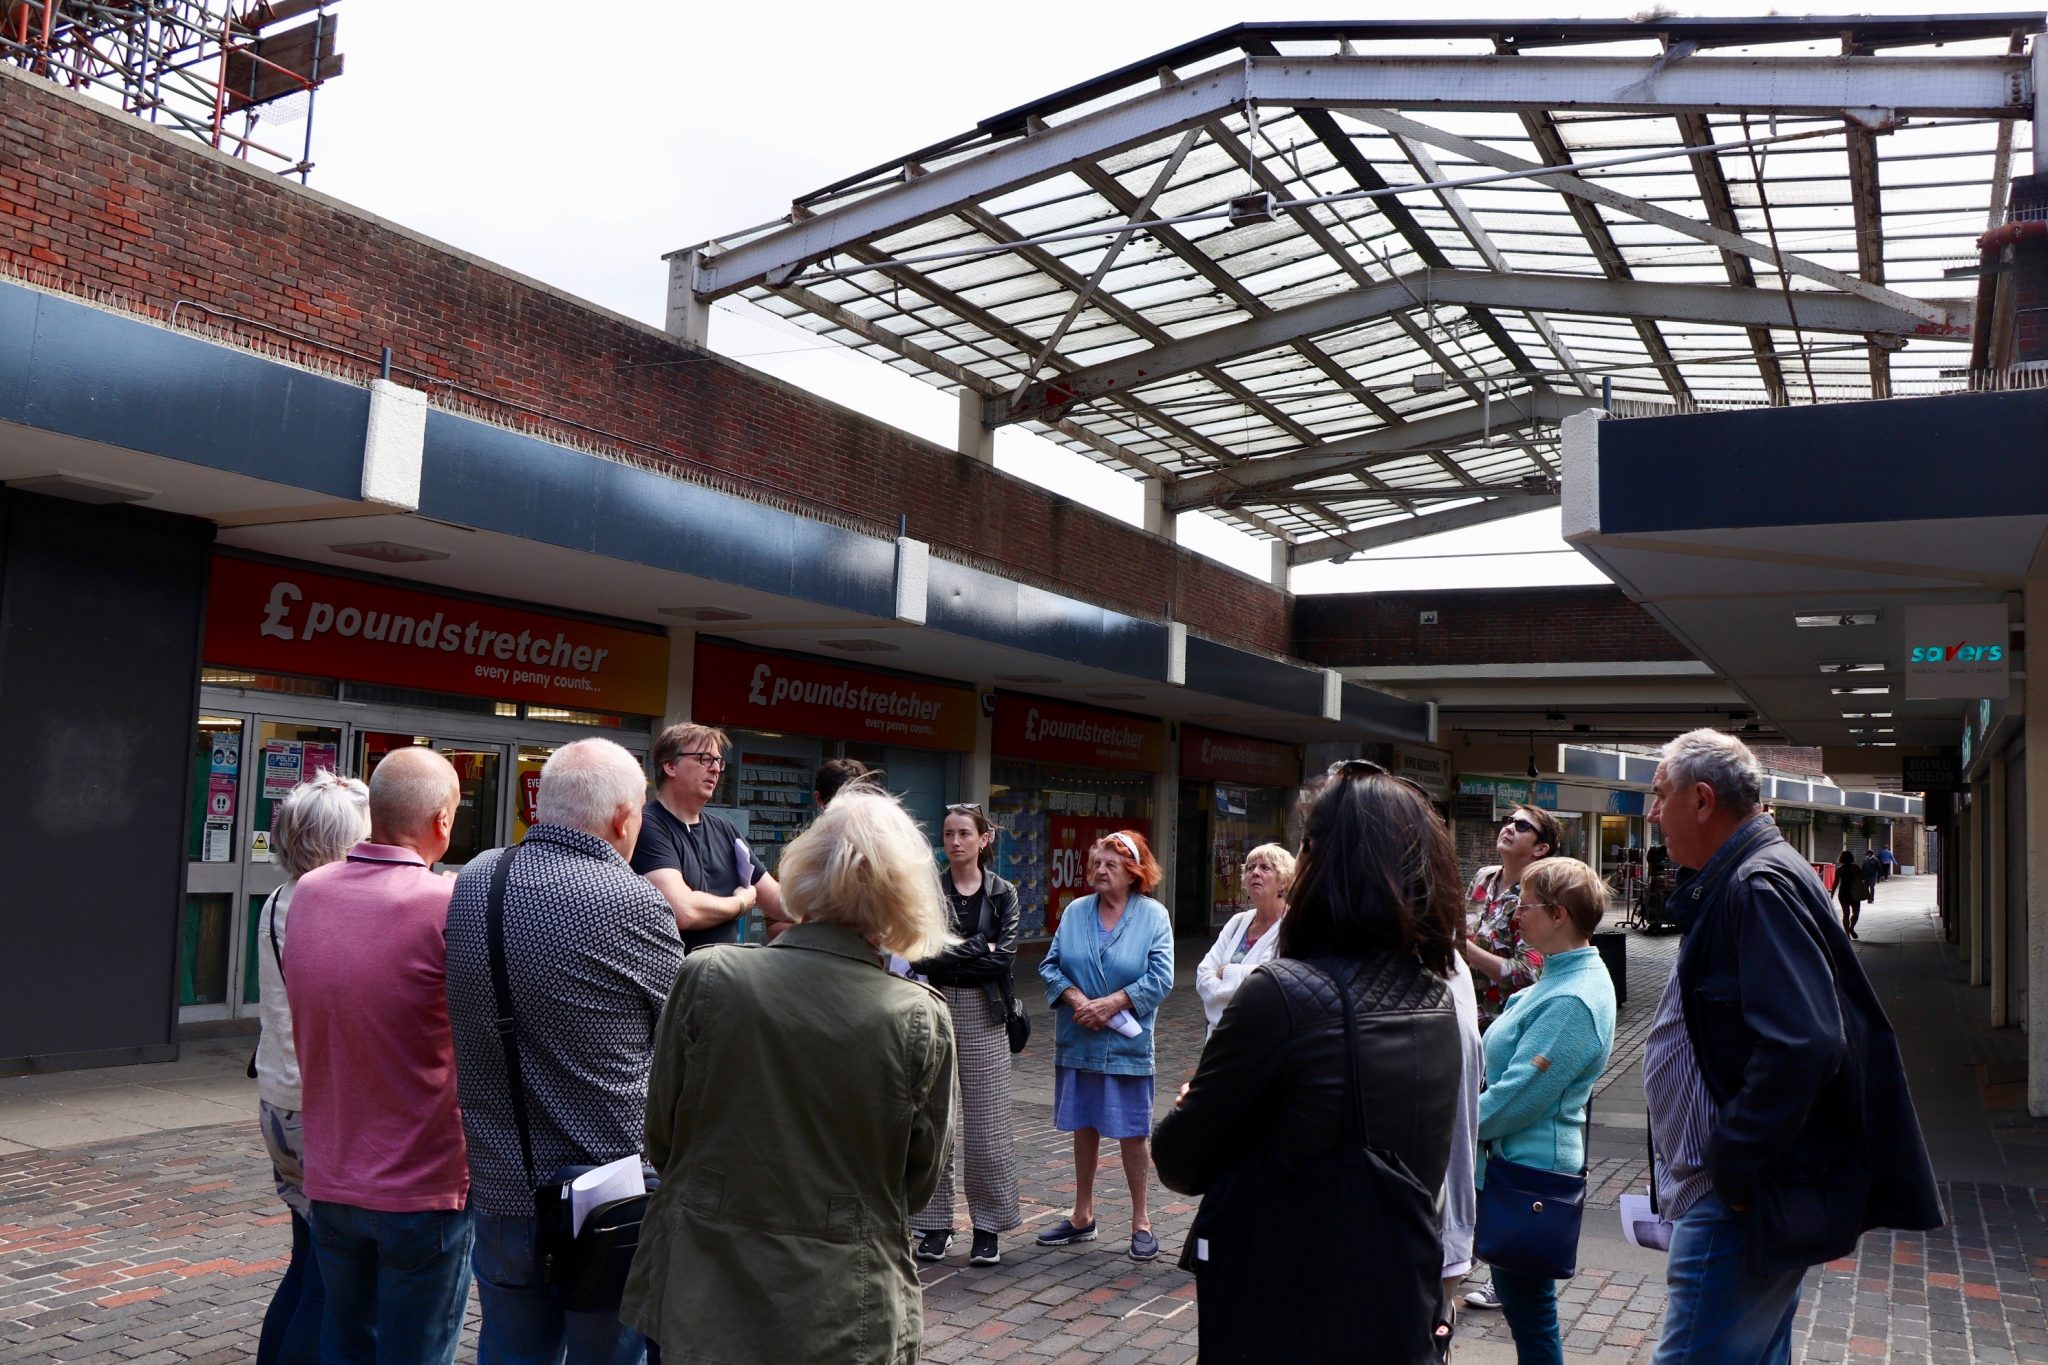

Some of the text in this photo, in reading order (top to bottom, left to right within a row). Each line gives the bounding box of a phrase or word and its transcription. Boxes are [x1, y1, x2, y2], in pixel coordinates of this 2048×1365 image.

[260, 581, 609, 673] £ poundstretcher
[1910, 640, 2002, 662] savers
[474, 664, 601, 693] every penny counts...
[771, 677, 943, 720] poundstretcher
[865, 718, 886, 730] every
[887, 720, 909, 734] penny
[1039, 718, 1144, 748] poundstretcher
[276, 755, 297, 763] POLICE
[1909, 759, 1952, 771] HOME
[1905, 770, 1954, 783] NEEDS
[1074, 877, 1084, 888] OFF
